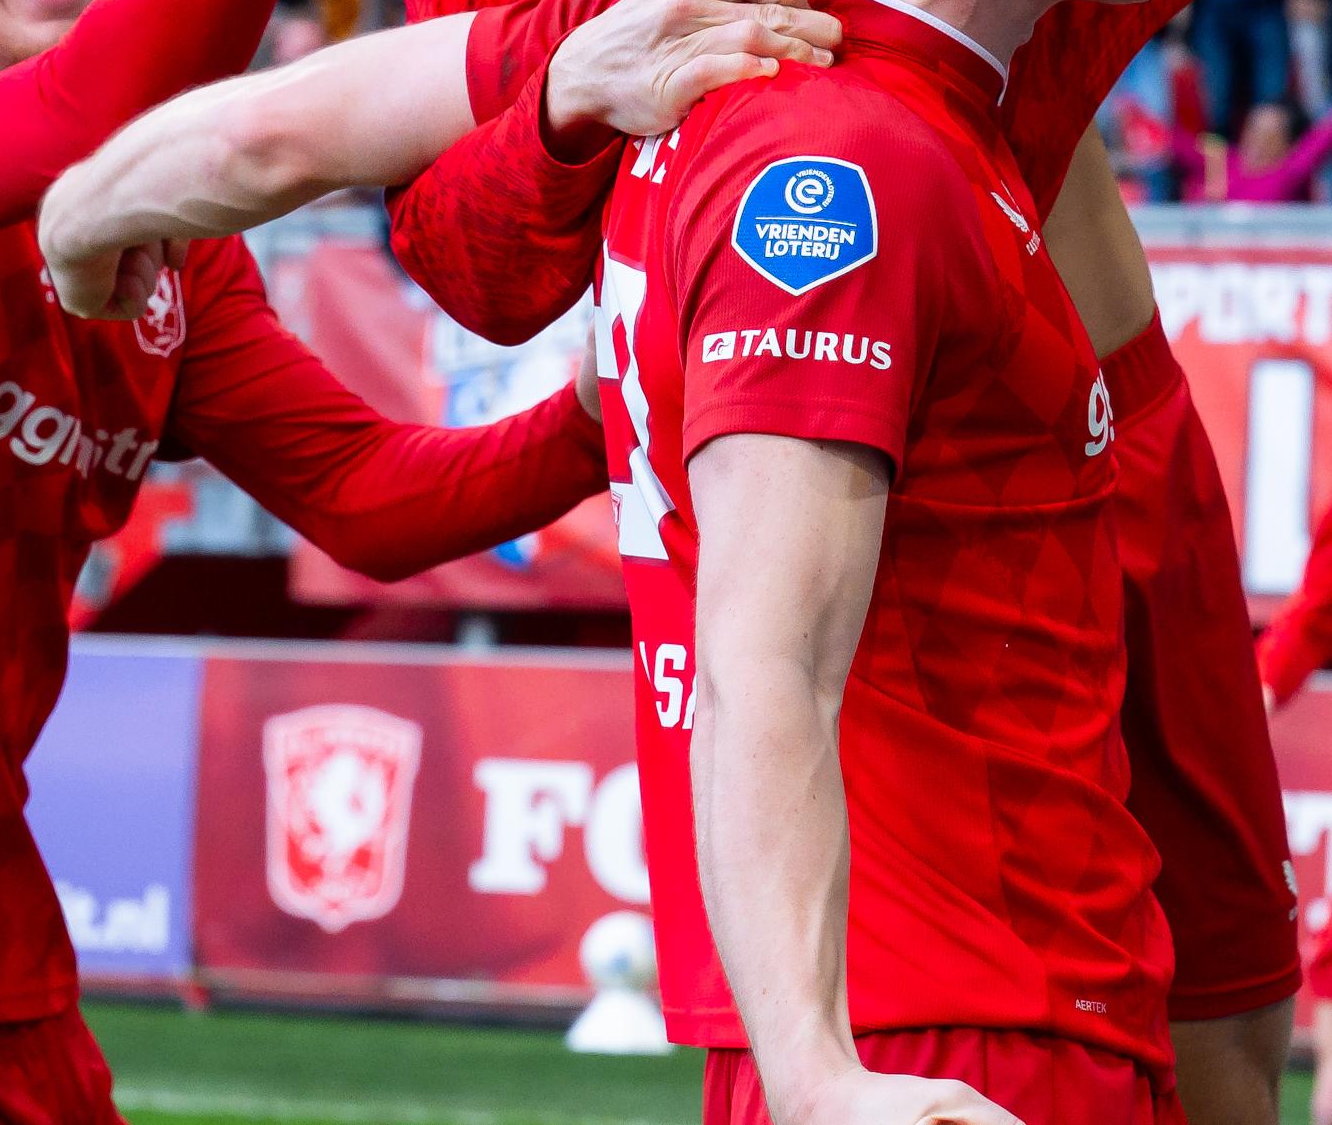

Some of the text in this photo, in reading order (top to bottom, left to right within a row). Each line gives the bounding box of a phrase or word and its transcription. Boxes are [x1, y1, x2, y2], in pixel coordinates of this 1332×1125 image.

[755, 223, 857, 246] VRIENDEN
[764, 240, 840, 261] LOTERIJ
[740, 328, 893, 371] TAURUS
[1075, 998, 1107, 1014] AERTEK
